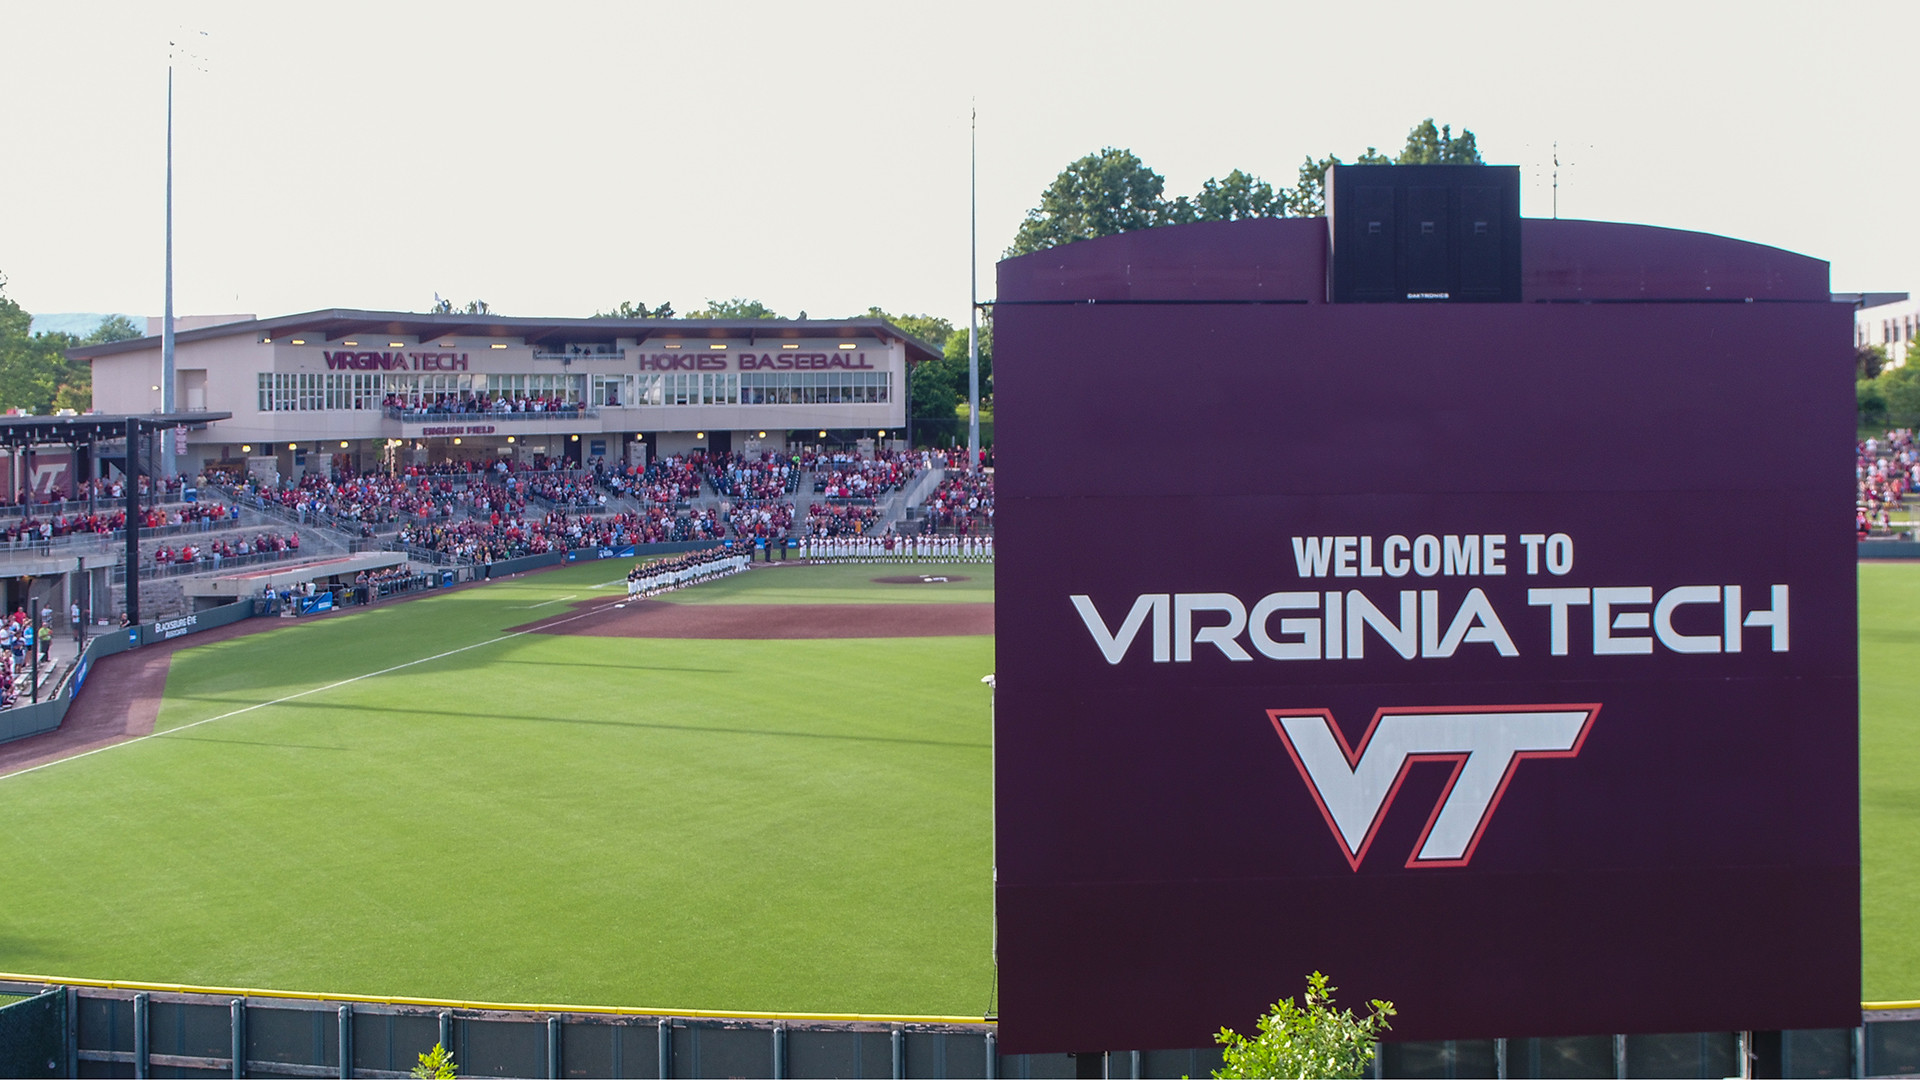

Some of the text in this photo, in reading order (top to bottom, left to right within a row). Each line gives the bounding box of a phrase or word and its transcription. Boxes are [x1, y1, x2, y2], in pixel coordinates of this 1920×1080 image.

[323, 350, 468, 371] VIRGINIA TECH
[640, 352, 874, 371] HOKIES BASEBALL
[423, 425, 495, 435] ENGLISH FIELD
[1292, 533, 1574, 578] WELCOME TO
[187, 615, 197, 626] EYE
[1070, 584, 1790, 664] VIRGINIA TECH
[1265, 703, 1602, 871] VT
